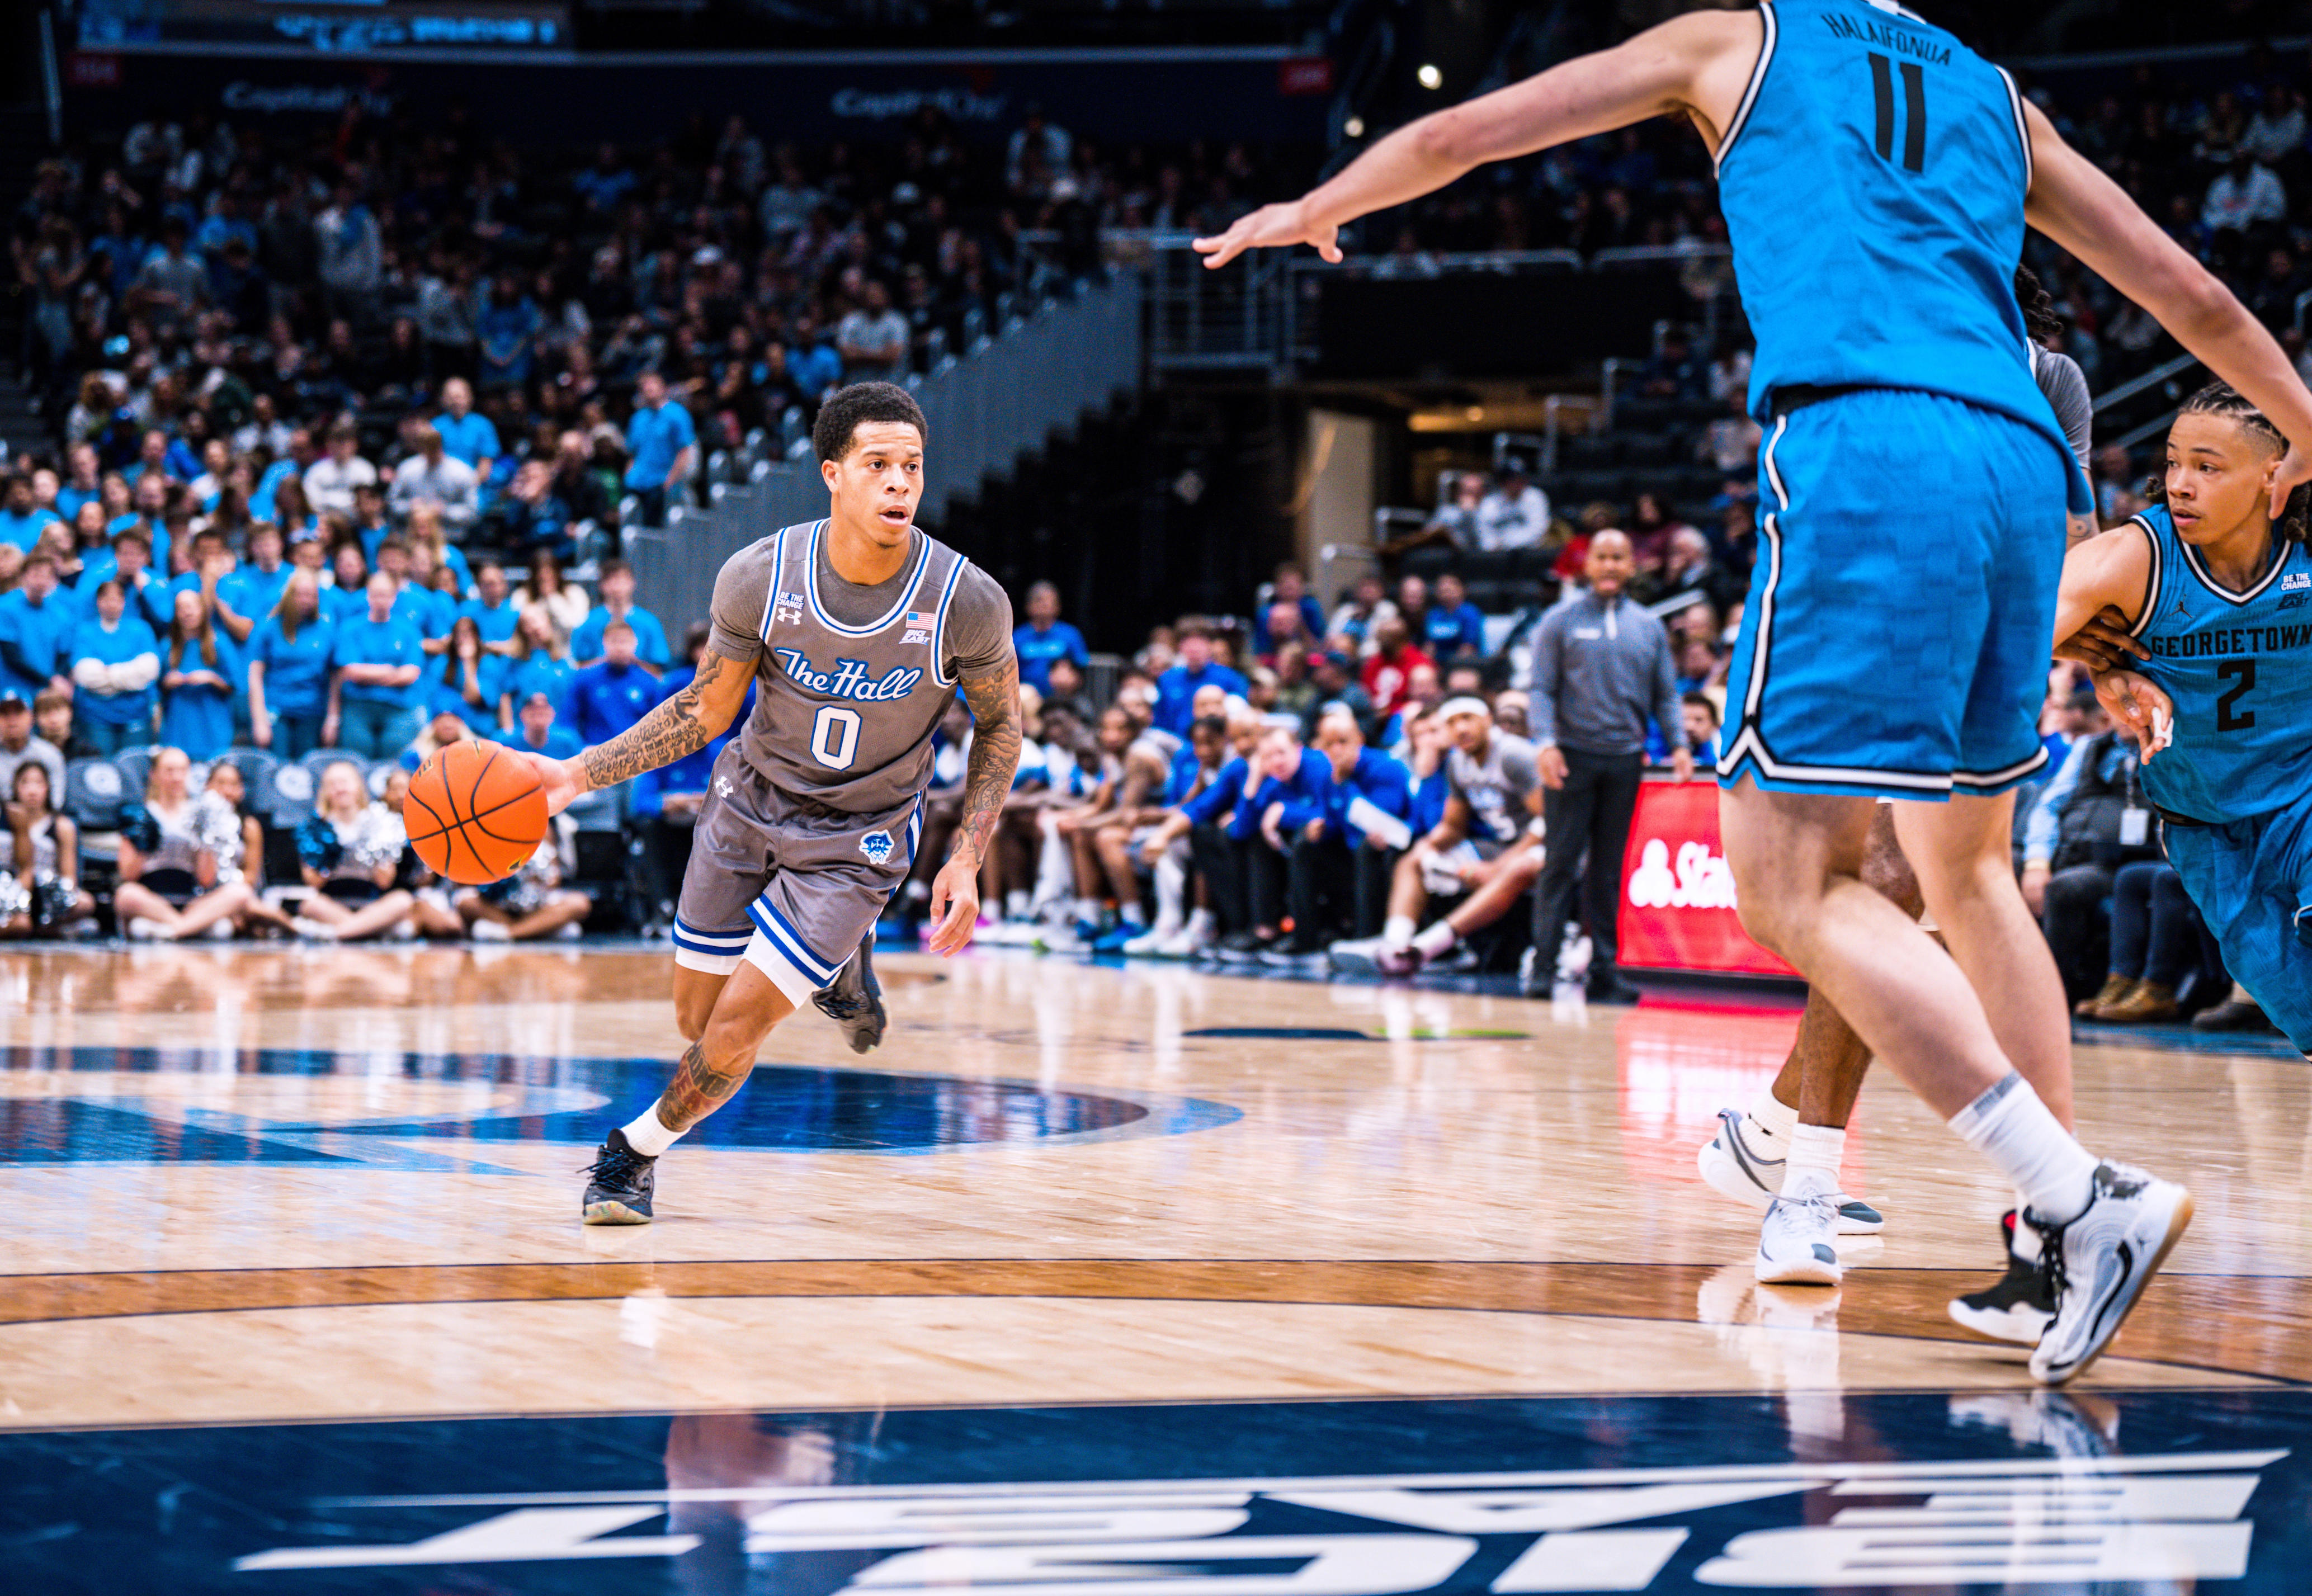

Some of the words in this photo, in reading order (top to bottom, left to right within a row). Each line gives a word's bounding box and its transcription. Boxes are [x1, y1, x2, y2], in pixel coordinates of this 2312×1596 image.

[1821, 13, 1951, 66] HALAIFONUA
[1868, 51, 1926, 173] 11
[780, 591, 790, 599] BE
[790, 593, 804, 602] THE
[2281, 580, 2311, 591] CHANGE
[2283, 592, 2305, 601] BIG
[2296, 573, 2309, 581] THE
[777, 598, 804, 610] CHANGE
[2278, 597, 2310, 608] EAST
[2152, 624, 2312, 657] GEORGETOWN
[774, 646, 831, 693] The
[832, 657, 923, 702] Hall
[2217, 659, 2255, 731] 2
[810, 705, 862, 771] 0
[230, 1474, 2258, 1570] EAST
[834, 1521, 2252, 1596] BIG
